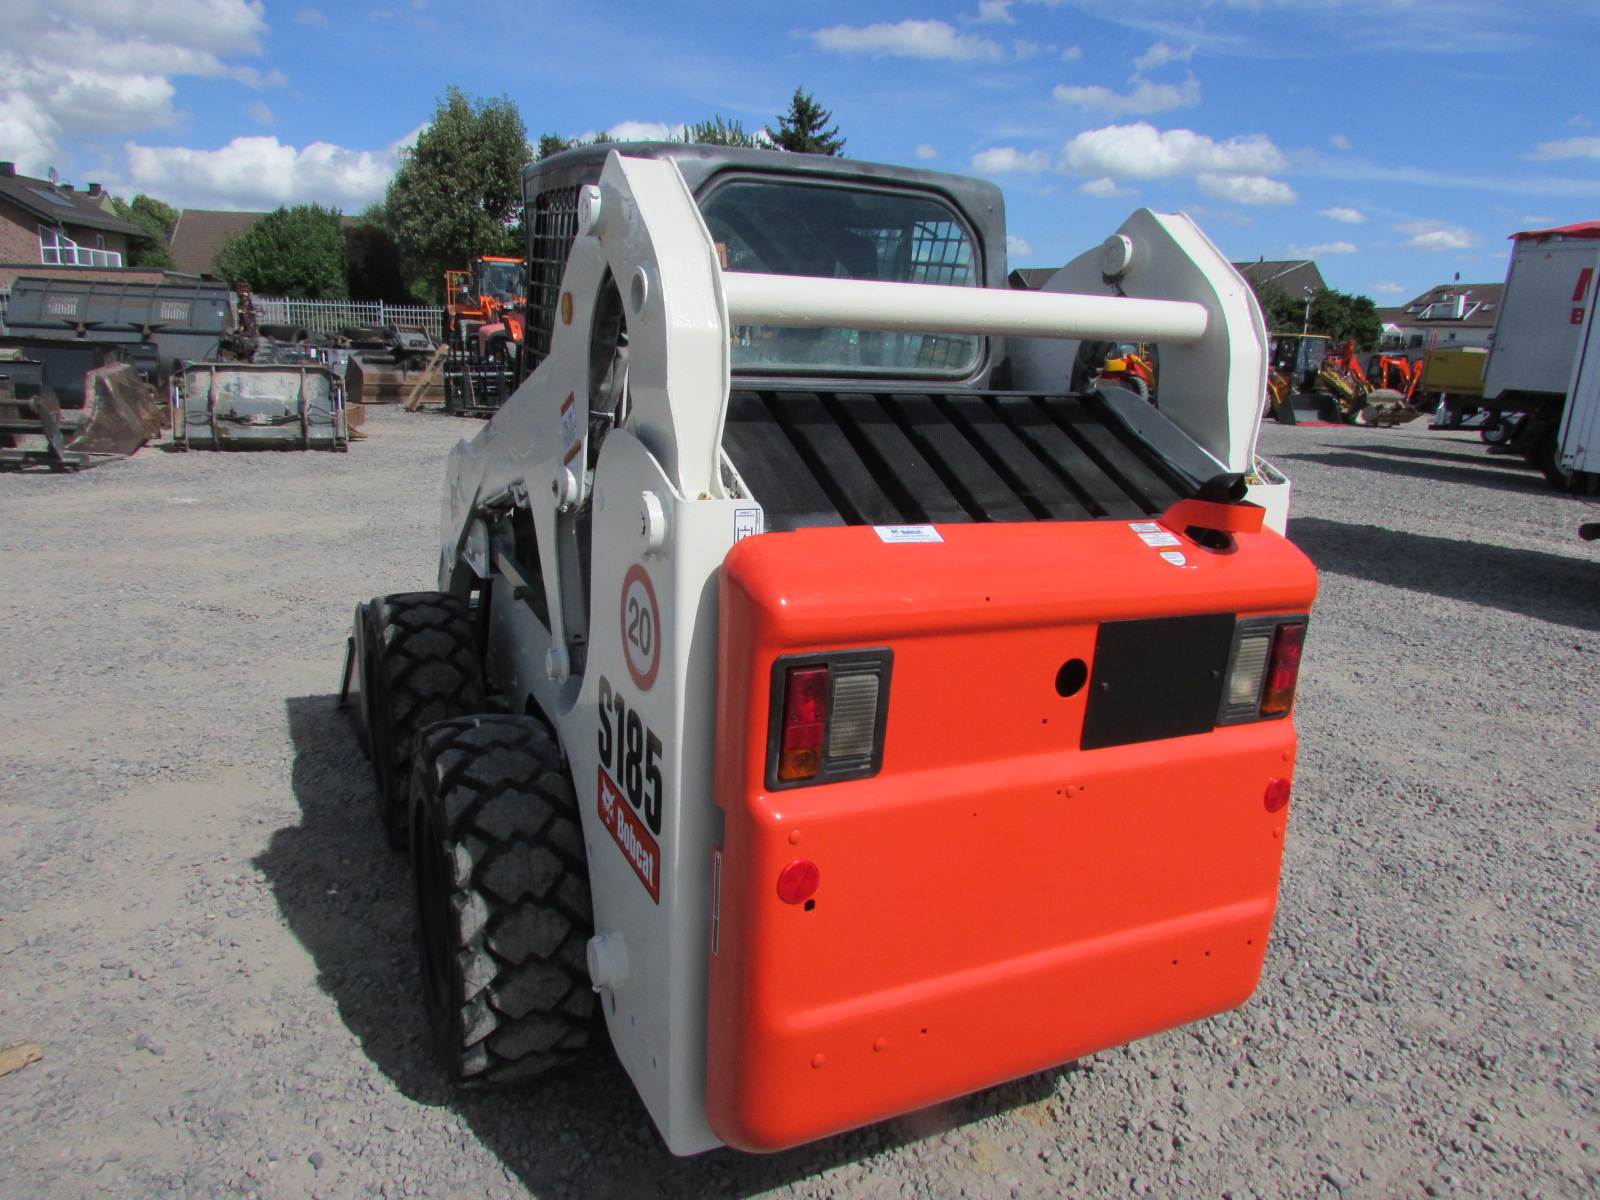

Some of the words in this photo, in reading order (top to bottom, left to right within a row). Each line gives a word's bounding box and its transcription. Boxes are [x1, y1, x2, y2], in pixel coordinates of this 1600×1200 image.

[628, 597, 651, 656] 20
[598, 675, 663, 836] S185
[617, 806, 655, 888] Bobcat
